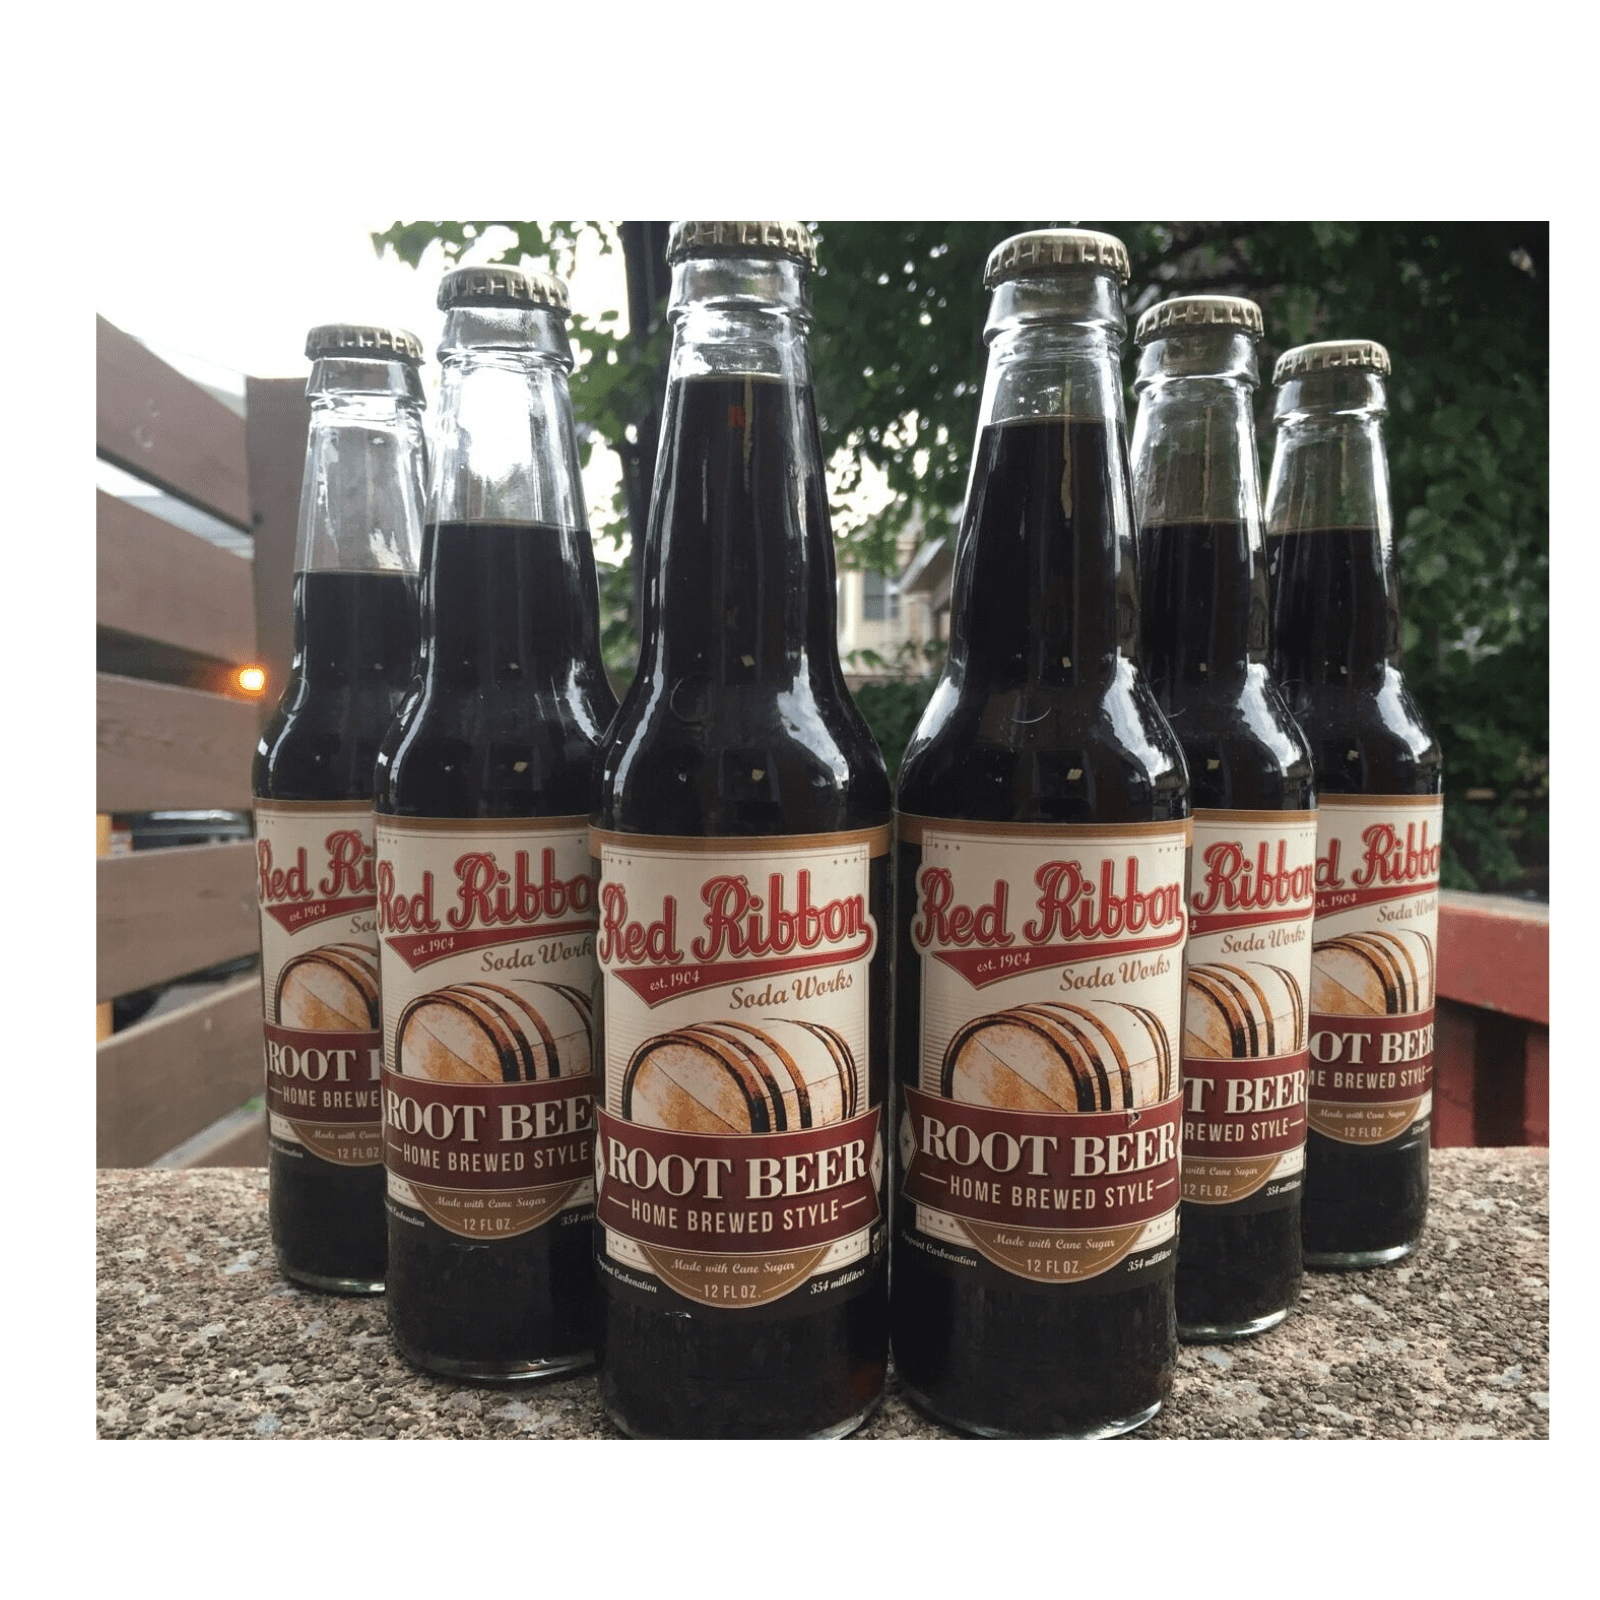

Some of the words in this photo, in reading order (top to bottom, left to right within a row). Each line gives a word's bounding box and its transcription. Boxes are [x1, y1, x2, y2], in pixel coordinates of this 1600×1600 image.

[1351, 820, 1440, 888] Ribbo
[377, 860, 440, 934] Red
[914, 866, 1015, 948] Red
[1022, 855, 1183, 946] Ribbon
[600, 881, 684, 964] Red
[691, 869, 868, 963] Ribbon
[1377, 903, 1413, 922] Soda
[429, 937, 455, 953] 1904
[1221, 934, 1265, 953] Soda
[1268, 925, 1305, 948] Works
[481, 949, 536, 972] Soda
[537, 936, 594, 964] Work
[977, 959, 997, 973] est.
[1000, 951, 1031, 968] 1904
[650, 977, 668, 991] est.
[671, 970, 700, 987] 1904
[1059, 965, 1116, 991] Soda
[1119, 954, 1171, 983] Works
[729, 984, 789, 1010] Soda
[792, 969, 853, 1000] Works
[1309, 1031, 1371, 1064] OT
[267, 1040, 356, 1082] ROOT
[1309, 1070, 1326, 1087] ME
[1334, 1071, 1396, 1089] BREWED
[1400, 1066, 1426, 1087] STYLE
[283, 1086, 317, 1107] HOME
[323, 1090, 380, 1108] BREWE
[1224, 1069, 1305, 1114] BEER
[387, 1089, 486, 1142] ROOT
[498, 1094, 593, 1142] BEE
[1185, 1122, 1245, 1142] REWED
[1251, 1119, 1289, 1141] STYLE
[1344, 1126, 1355, 1137] 12
[338, 1148, 349, 1159] 12
[403, 1142, 440, 1169] HOME
[448, 1152, 525, 1173] BREWED
[534, 1141, 588, 1169] STYLE
[921, 1114, 1057, 1176] ROOT
[1070, 1121, 1176, 1177] BEER
[607, 1136, 732, 1200] ROOT
[745, 1138, 867, 1200] BEER
[1185, 1166, 1205, 1175] with
[1209, 1166, 1231, 1176] Cane
[1234, 1166, 1258, 1178] Sugar
[950, 1174, 1001, 1204] HOME
[1011, 1186, 1096, 1210] BREWED
[1105, 1179, 1154, 1208] STYLE
[1183, 1183, 1196, 1195] 12
[435, 1196, 461, 1208] Made
[464, 1198, 484, 1209] with
[488, 1198, 512, 1209] Cane
[516, 1197, 546, 1209] Sugar
[463, 1218, 476, 1230] 12
[631, 1198, 678, 1229] HOME
[688, 1210, 773, 1233] BREWED
[783, 1198, 839, 1231] STYLE
[993, 1233, 1025, 1247] Made
[1028, 1237, 1051, 1250] with
[1056, 1237, 1082, 1250] Cane
[1085, 1236, 1116, 1251] Sugar
[671, 1258, 702, 1272] Made
[705, 1261, 728, 1274] with
[732, 1261, 760, 1274] Cane
[763, 1260, 795, 1274] Sugar
[1027, 1258, 1041, 1273] 12
[1127, 1258, 1144, 1272] 354
[703, 1284, 719, 1299] 12
[810, 1277, 830, 1295] 354
